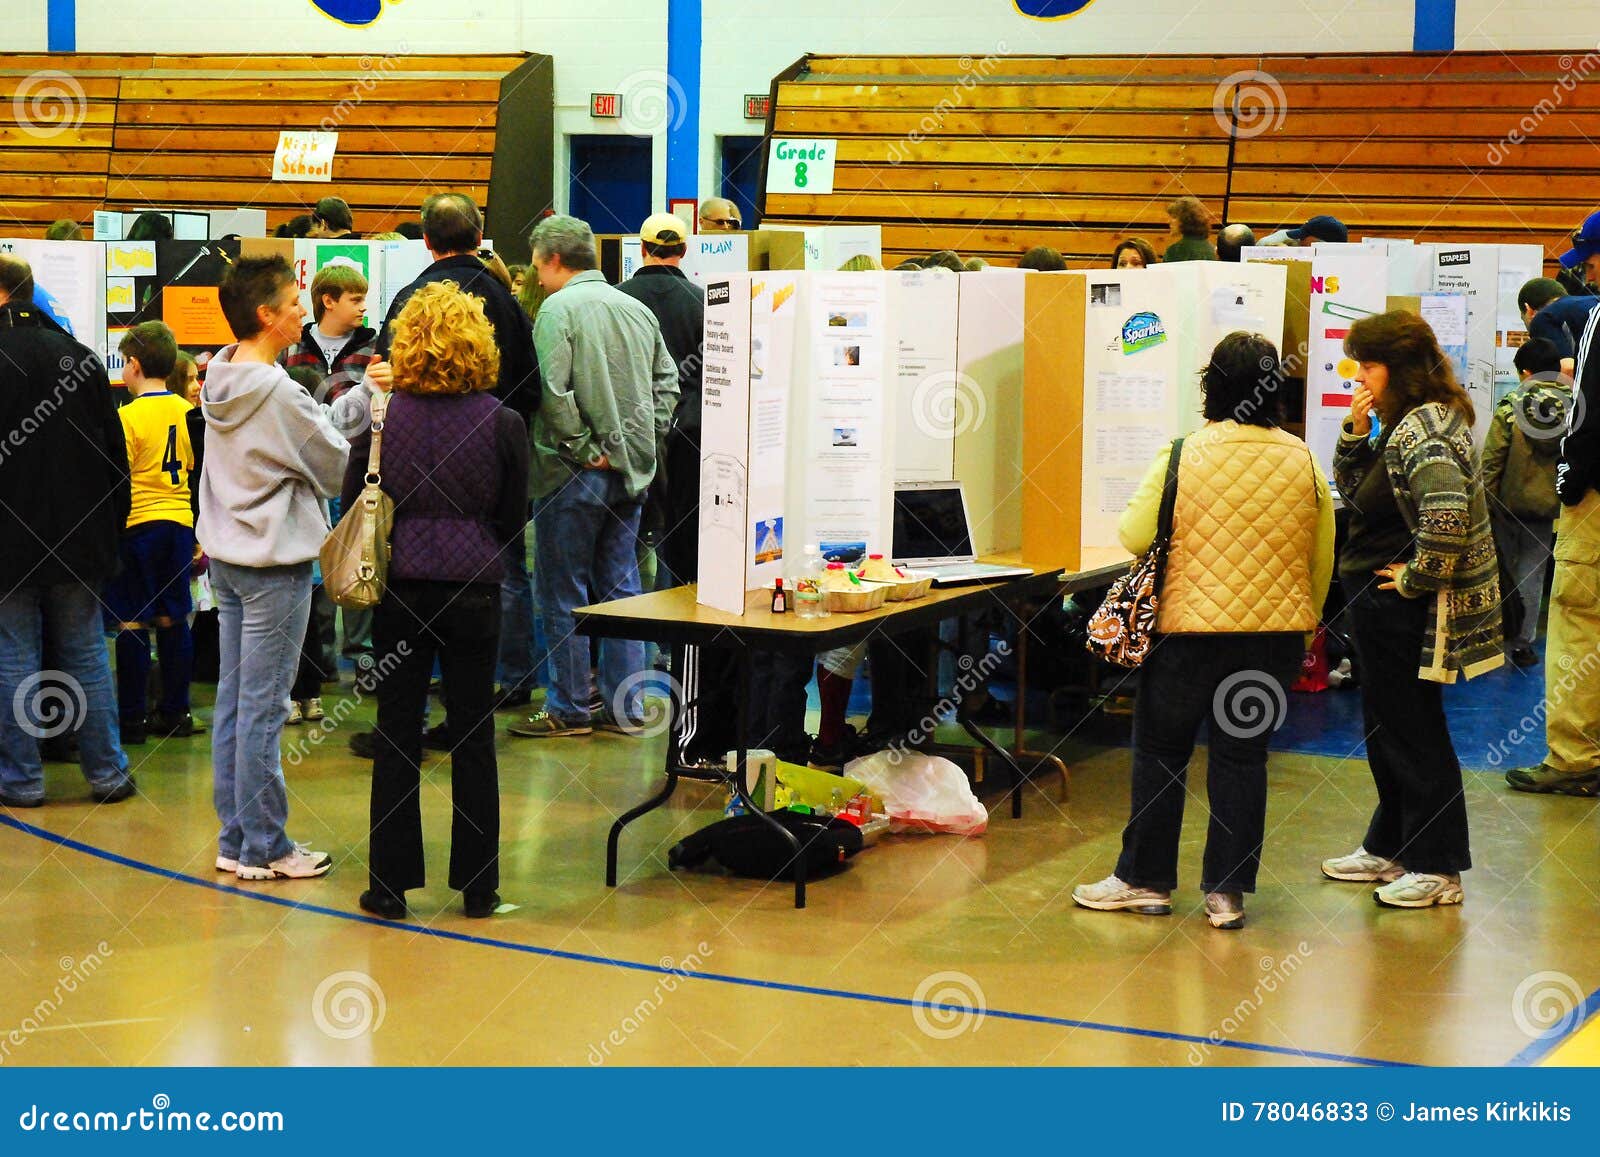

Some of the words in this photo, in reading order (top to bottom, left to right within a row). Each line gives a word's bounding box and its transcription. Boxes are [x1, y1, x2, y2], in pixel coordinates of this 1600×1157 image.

[595, 96, 615, 115] EXIT
[776, 141, 826, 161] Grade
[282, 154, 329, 175] School
[794, 162, 808, 187] 8
[701, 240, 733, 255] PLAN
[1440, 253, 1469, 263] STAPLES
[708, 286, 729, 300] STAPLES
[161, 424, 182, 485] 4
